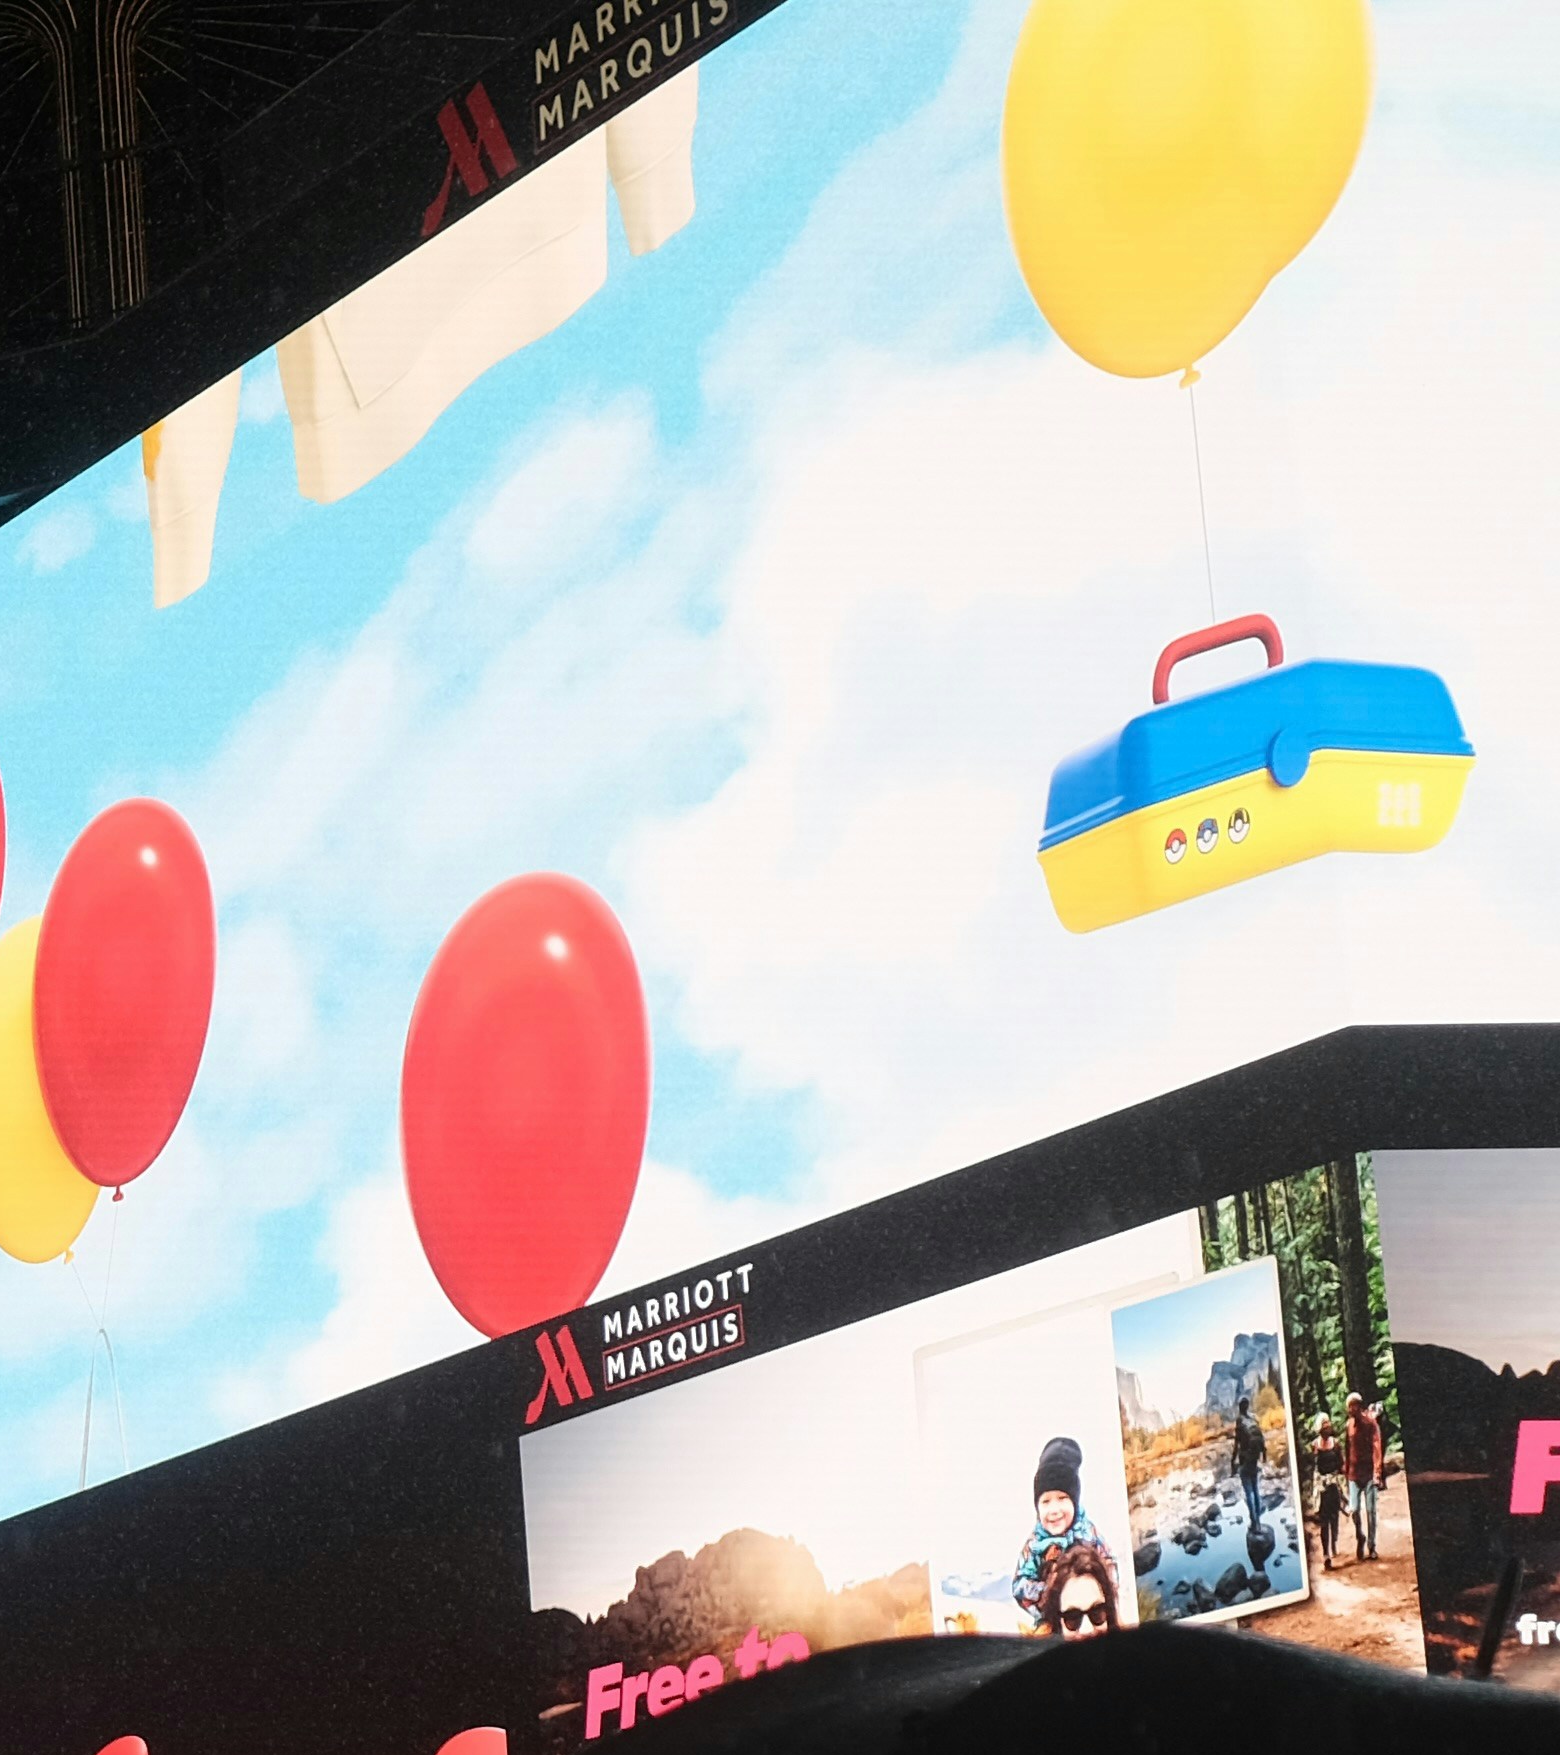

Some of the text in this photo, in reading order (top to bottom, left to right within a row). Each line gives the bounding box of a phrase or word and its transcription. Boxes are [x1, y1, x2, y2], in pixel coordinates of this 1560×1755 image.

[539, 0, 729, 142] MARQUIS
[603, 1263, 754, 1342] MARRIOTT
[606, 1312, 739, 1385] MARQUIS
[585, 1661, 723, 1740] Free
